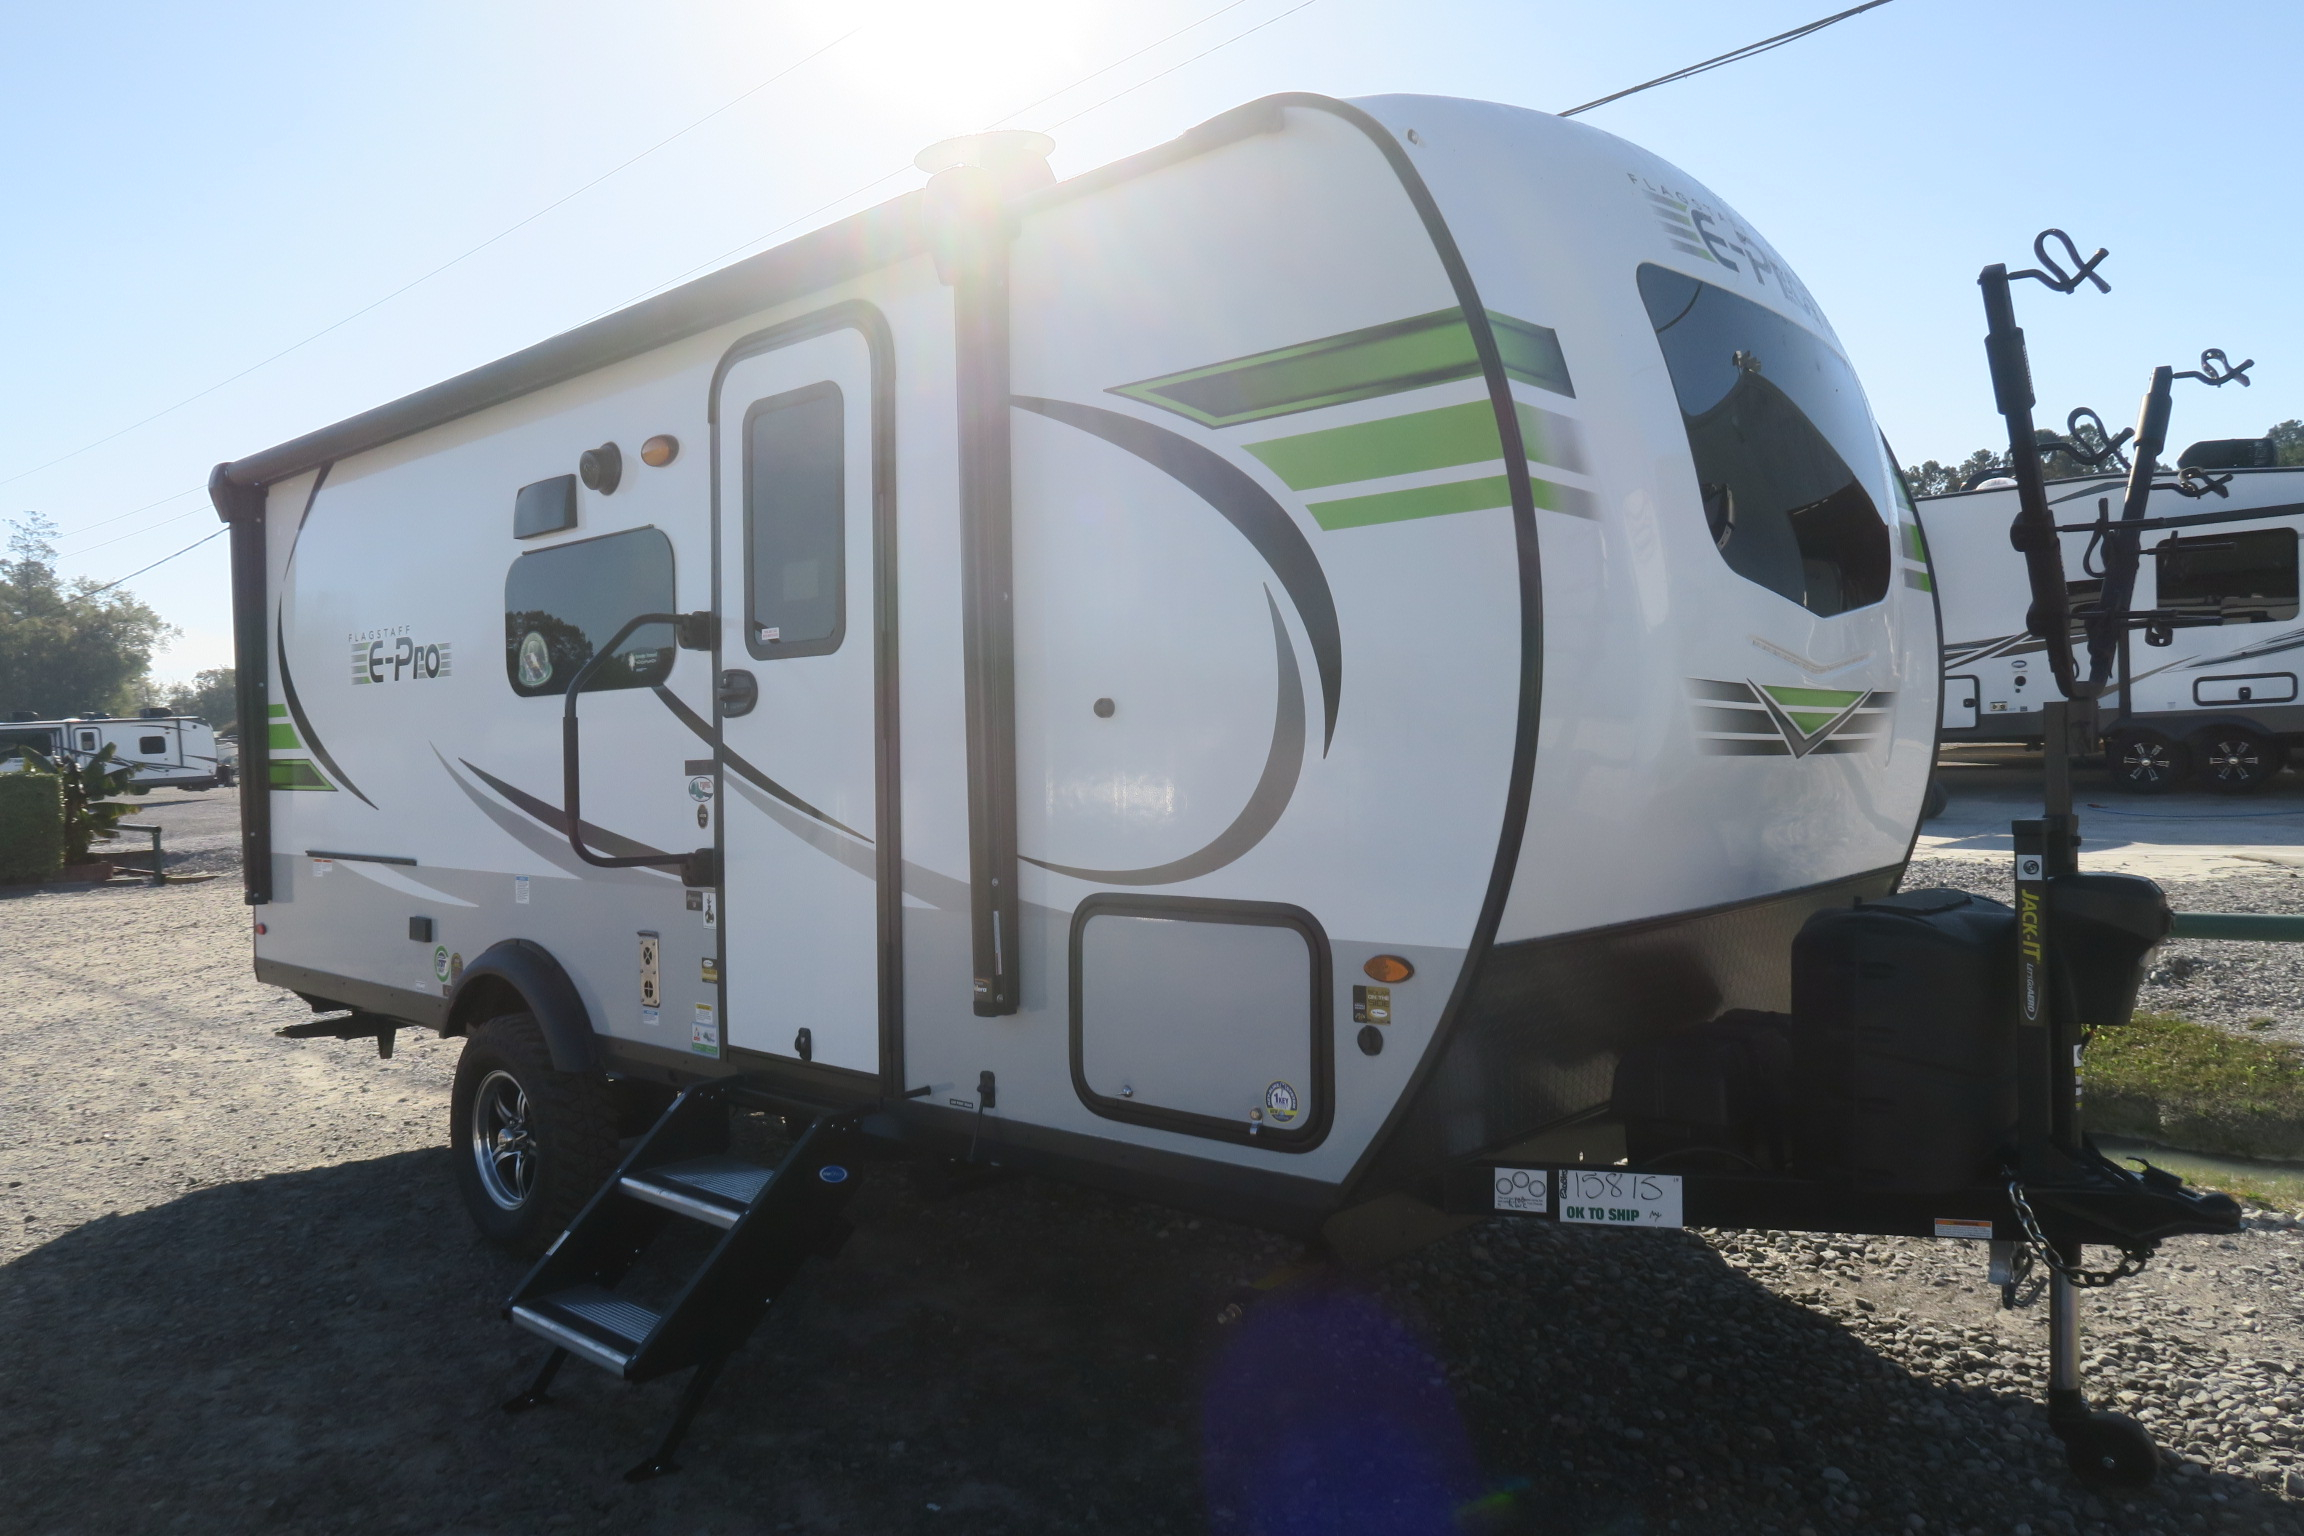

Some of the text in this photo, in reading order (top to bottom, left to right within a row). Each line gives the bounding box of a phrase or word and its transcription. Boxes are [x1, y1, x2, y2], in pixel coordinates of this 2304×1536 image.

[348, 625, 411, 642] FLAGSTAFF
[2021, 888, 2042, 963] JACK-IT
[1566, 1205, 1585, 1220] OK
[1589, 1207, 1605, 1221] TO
[1608, 1208, 1640, 1222] SHIP
